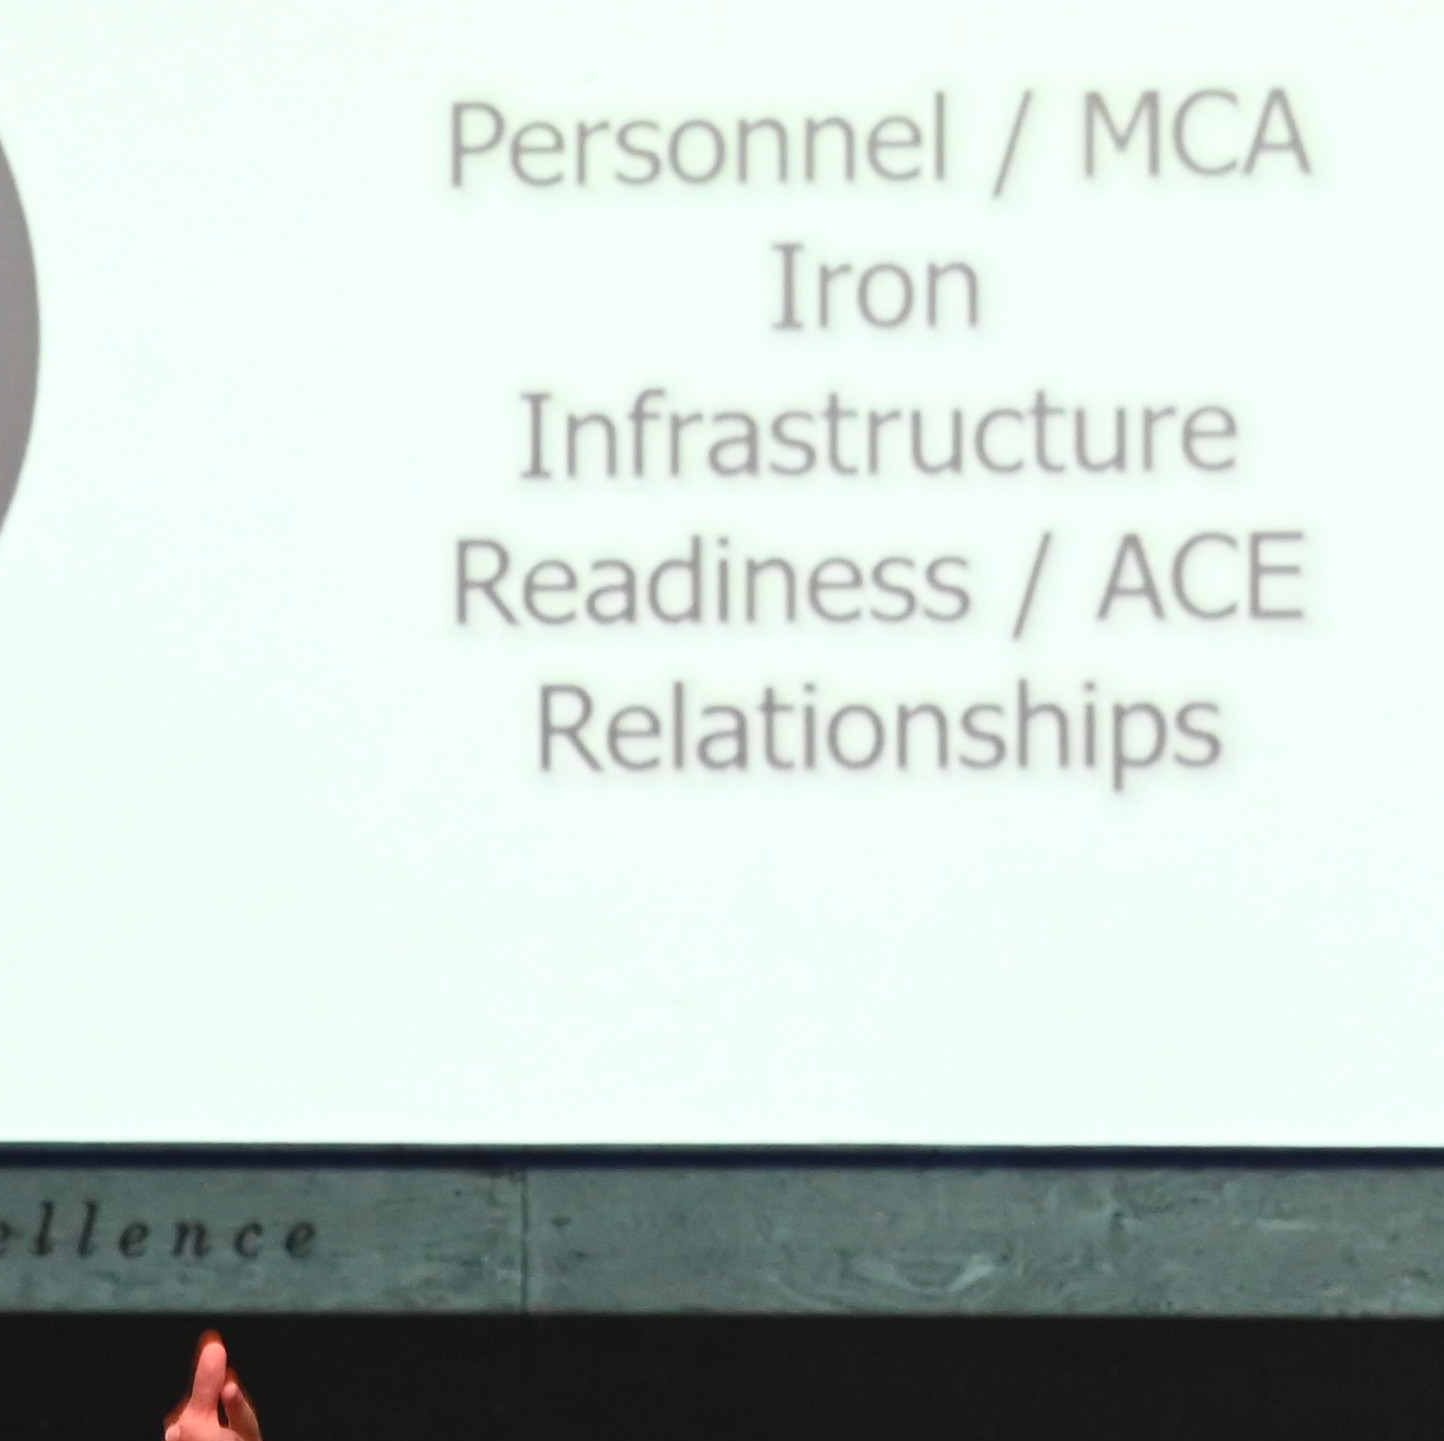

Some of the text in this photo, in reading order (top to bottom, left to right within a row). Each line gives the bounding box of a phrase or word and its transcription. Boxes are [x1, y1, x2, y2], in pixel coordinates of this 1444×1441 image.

[449, 87, 1314, 199] Personnel / MCA
[771, 242, 980, 332] Iron
[519, 387, 1240, 481] Infrastructure
[454, 530, 1306, 641] Readiness / ACE
[538, 677, 1224, 794] Relationships
